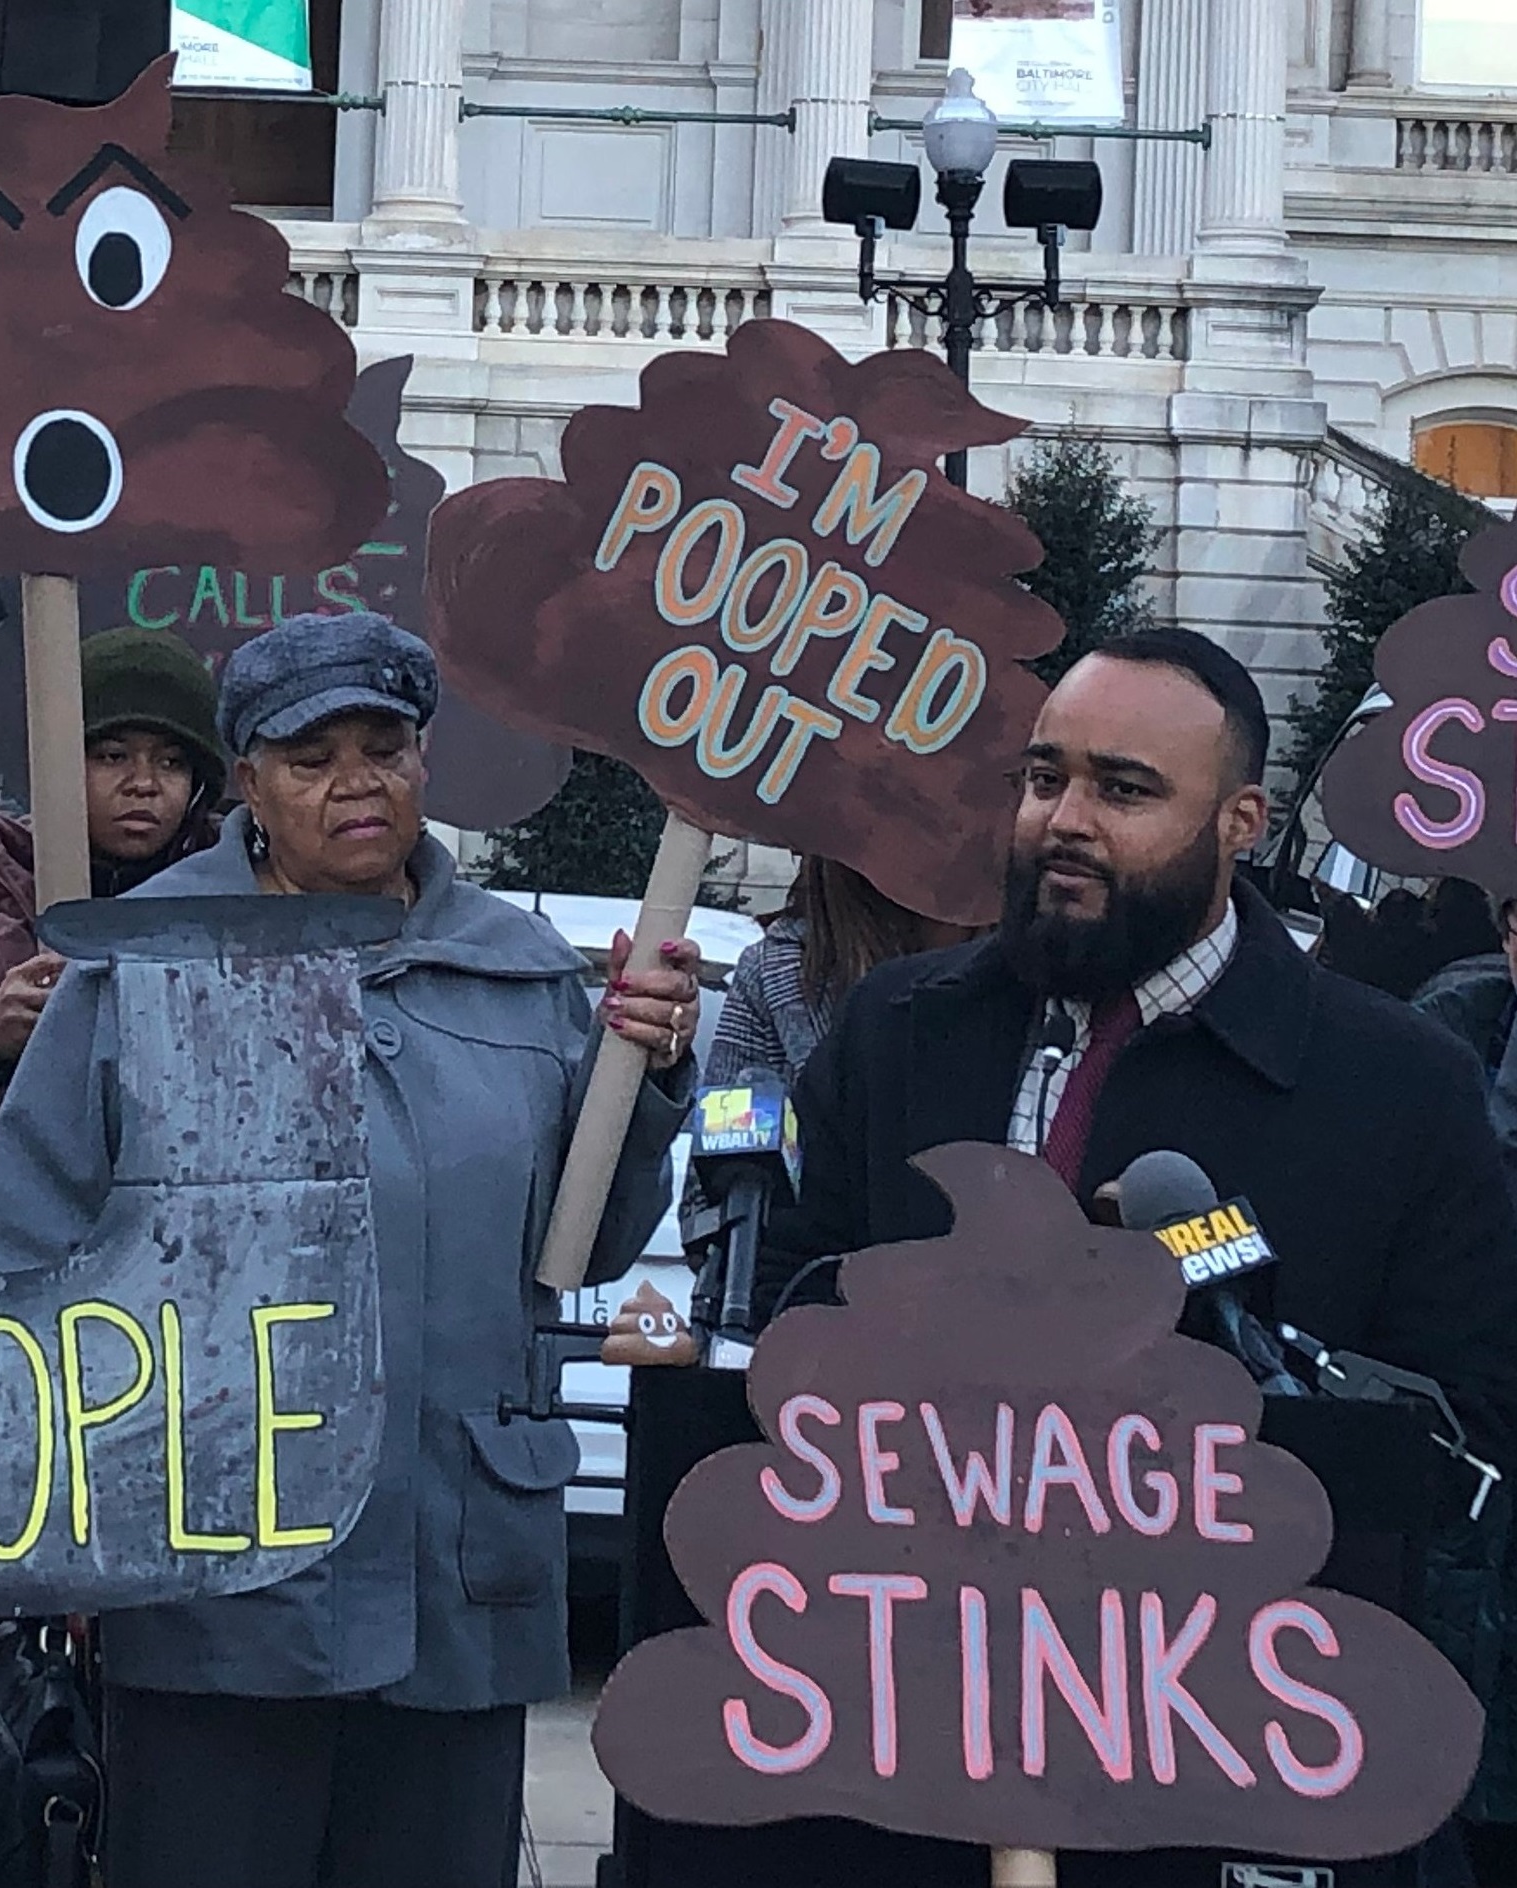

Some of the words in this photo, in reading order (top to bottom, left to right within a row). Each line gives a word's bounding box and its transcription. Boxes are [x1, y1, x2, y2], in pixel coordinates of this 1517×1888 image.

[1016, 67, 1093, 80] BALTIMORE
[731, 397, 928, 567] I'M
[126, 563, 372, 631] CALLS
[594, 461, 988, 755] POOPED
[637, 644, 844, 804] OUT
[1167, 1203, 1258, 1257] REAL
[1181, 1235, 1262, 1286] ews
[758, 1392, 1254, 1543] SEWAGE
[721, 1560, 1366, 1799] STINKS
